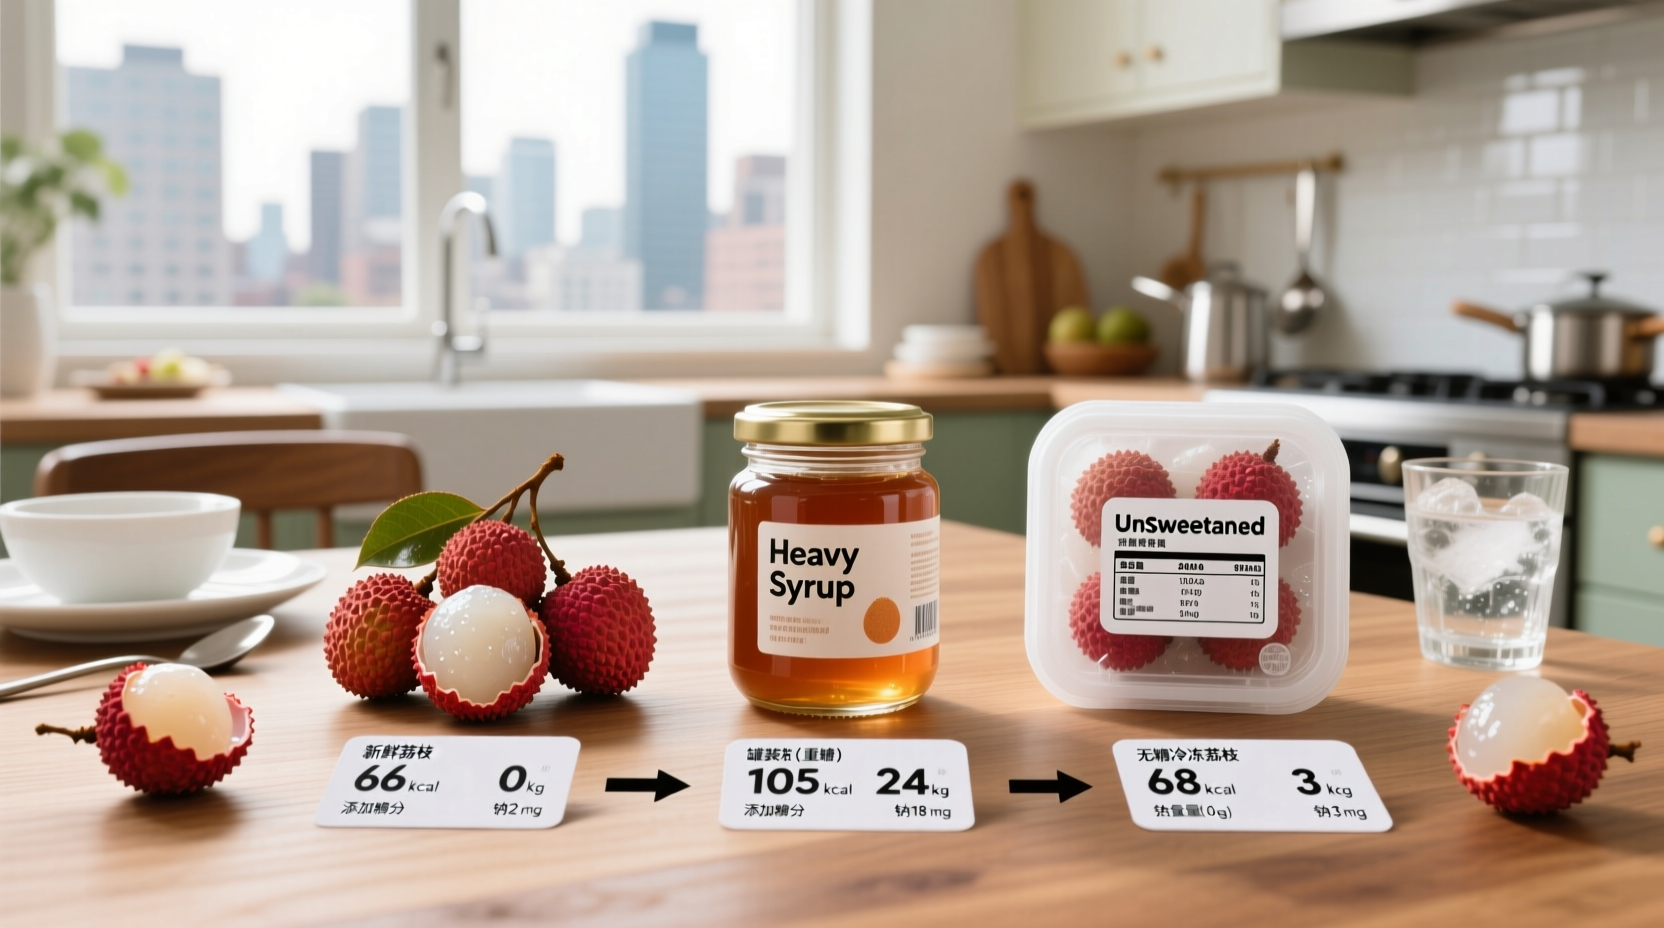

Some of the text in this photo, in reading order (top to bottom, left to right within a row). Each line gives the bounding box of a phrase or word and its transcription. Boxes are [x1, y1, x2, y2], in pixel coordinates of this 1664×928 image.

[769, 538, 860, 575] Heavy
[769, 570, 855, 607] Syrup
[354, 763, 440, 793] 66 kcal
[498, 764, 545, 796] 0 kg
[747, 767, 853, 796] 105 kcal
[875, 767, 950, 799] 24 kg
[1147, 767, 1237, 796] 68 kcal
[1291, 767, 1322, 796] 3
